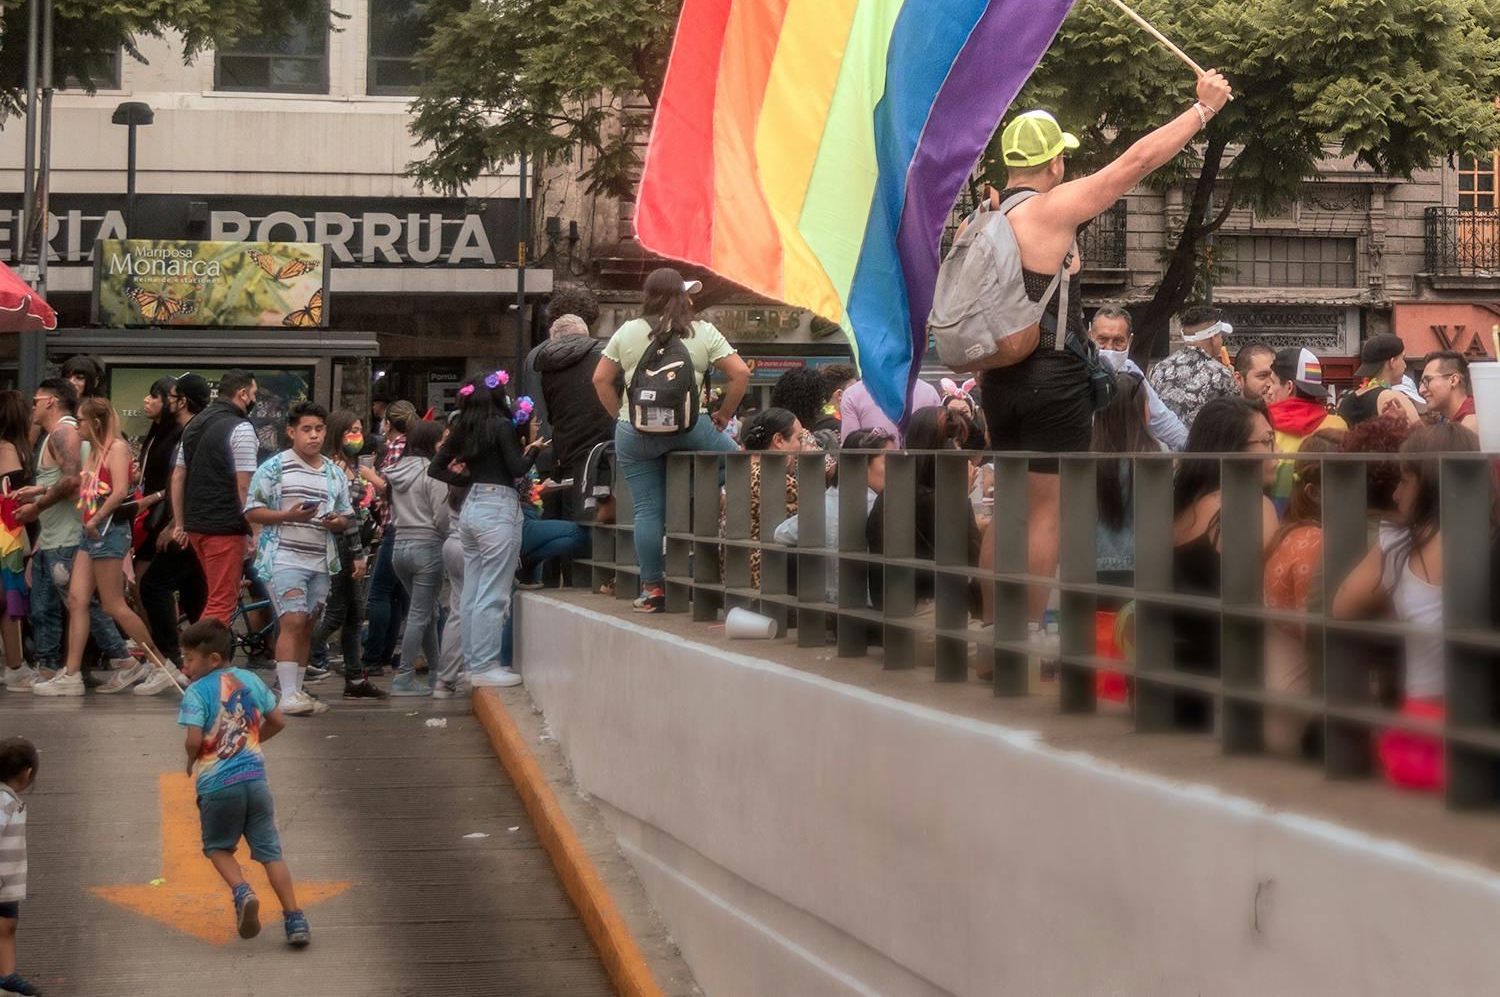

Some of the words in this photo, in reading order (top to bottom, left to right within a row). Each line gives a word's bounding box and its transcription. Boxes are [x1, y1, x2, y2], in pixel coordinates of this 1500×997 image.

[210, 210, 497, 264] PORRUA
[135, 246, 193, 259] Mariposa
[109, 253, 220, 276] Monarca
